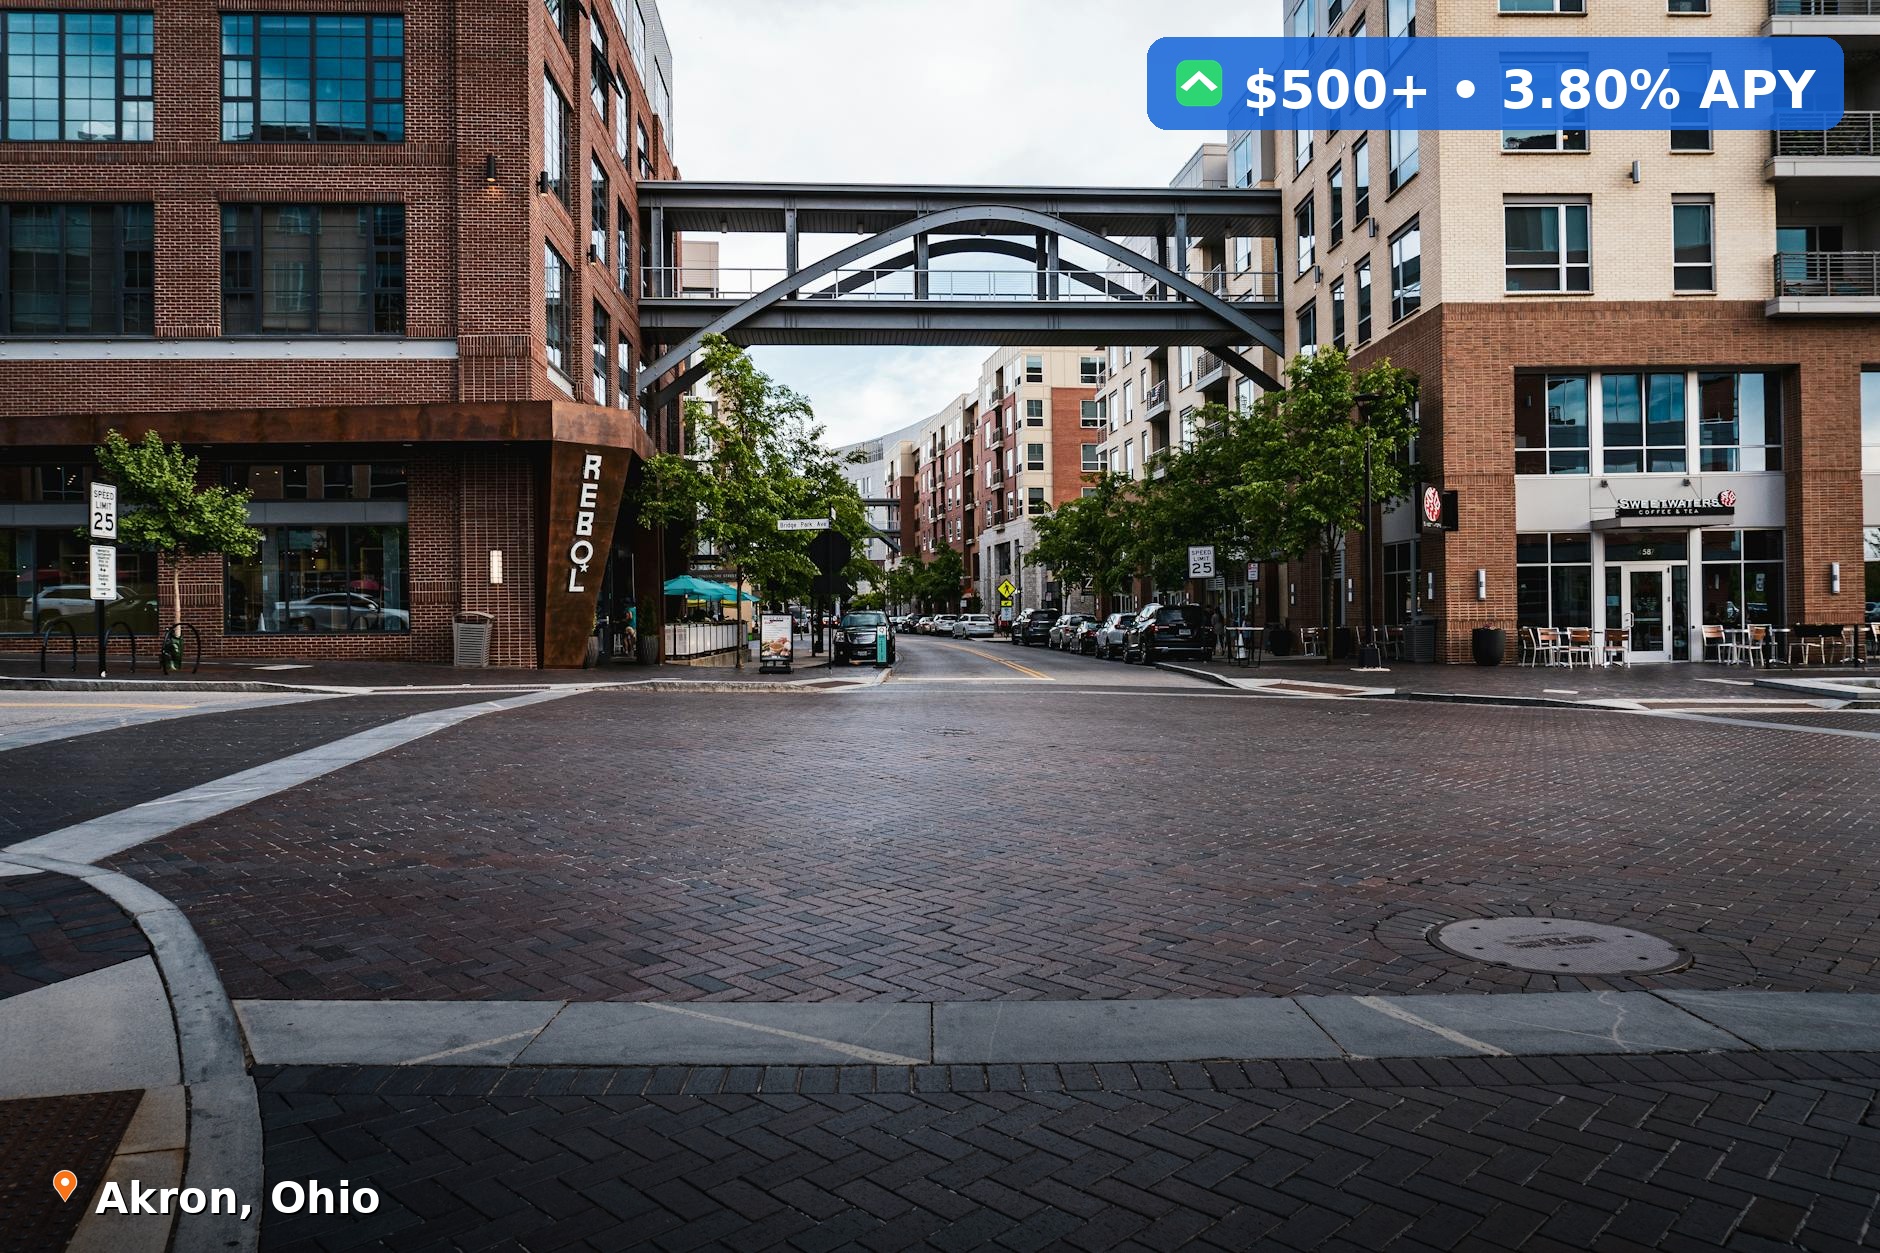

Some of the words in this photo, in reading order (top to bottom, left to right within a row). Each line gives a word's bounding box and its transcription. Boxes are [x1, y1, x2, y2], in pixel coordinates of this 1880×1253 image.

[94, 490, 114, 500] SPEED
[96, 501, 111, 510] LIMIT
[1619, 498, 1719, 510] SWEETWATERS
[1638, 508, 1671, 516] COFFEE
[94, 512, 114, 531] 25
[569, 454, 602, 592] REBOL
[1192, 562, 1212, 574] 25
